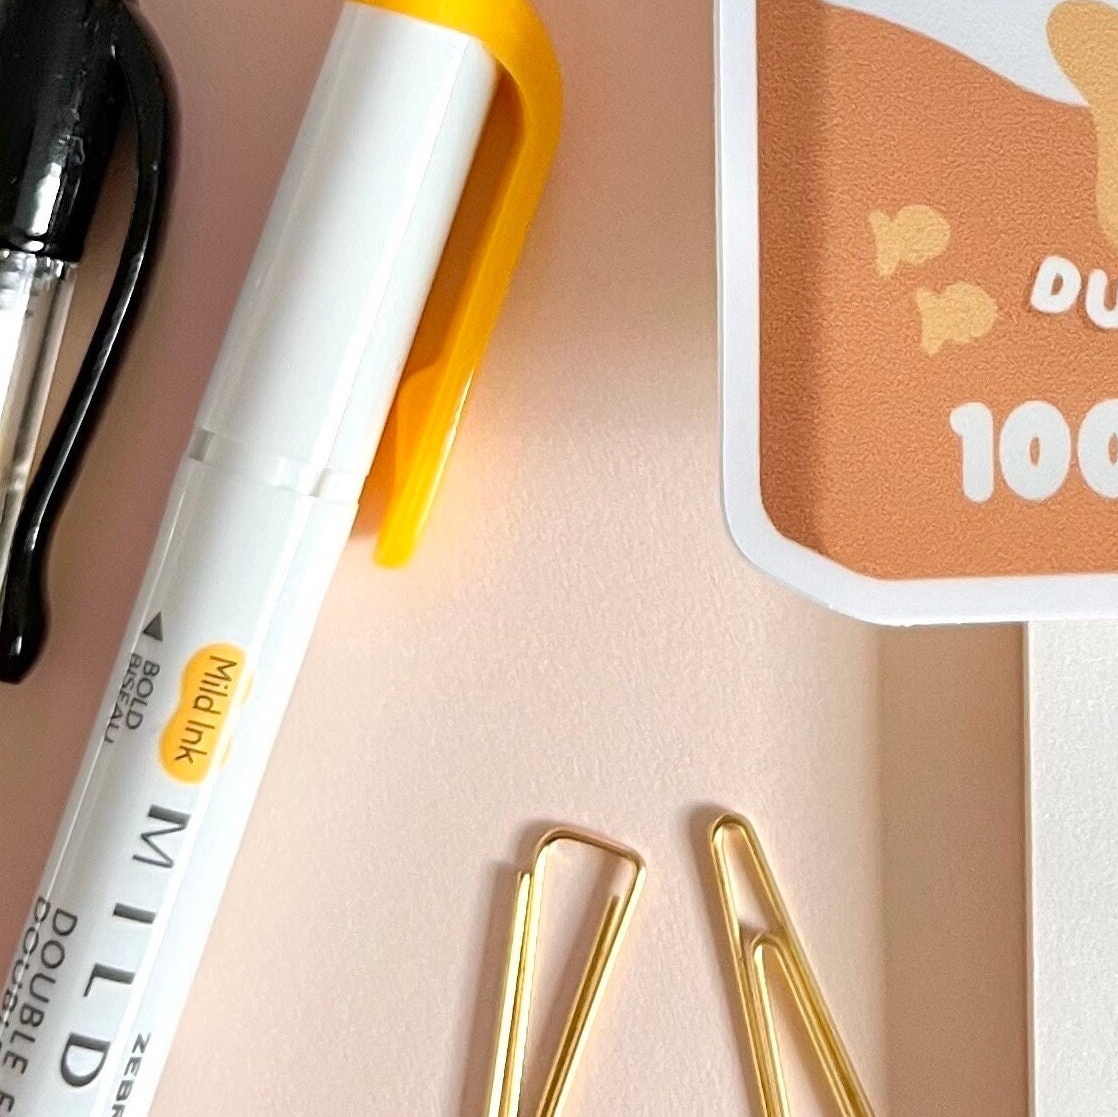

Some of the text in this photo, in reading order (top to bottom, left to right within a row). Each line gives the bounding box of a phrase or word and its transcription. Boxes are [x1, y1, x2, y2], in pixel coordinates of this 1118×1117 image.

[125, 660, 160, 730] BOLD
[174, 655, 238, 764] Mild Ink
[3, 908, 78, 1075] DOUBLE
[59, 803, 191, 1088] MILD
